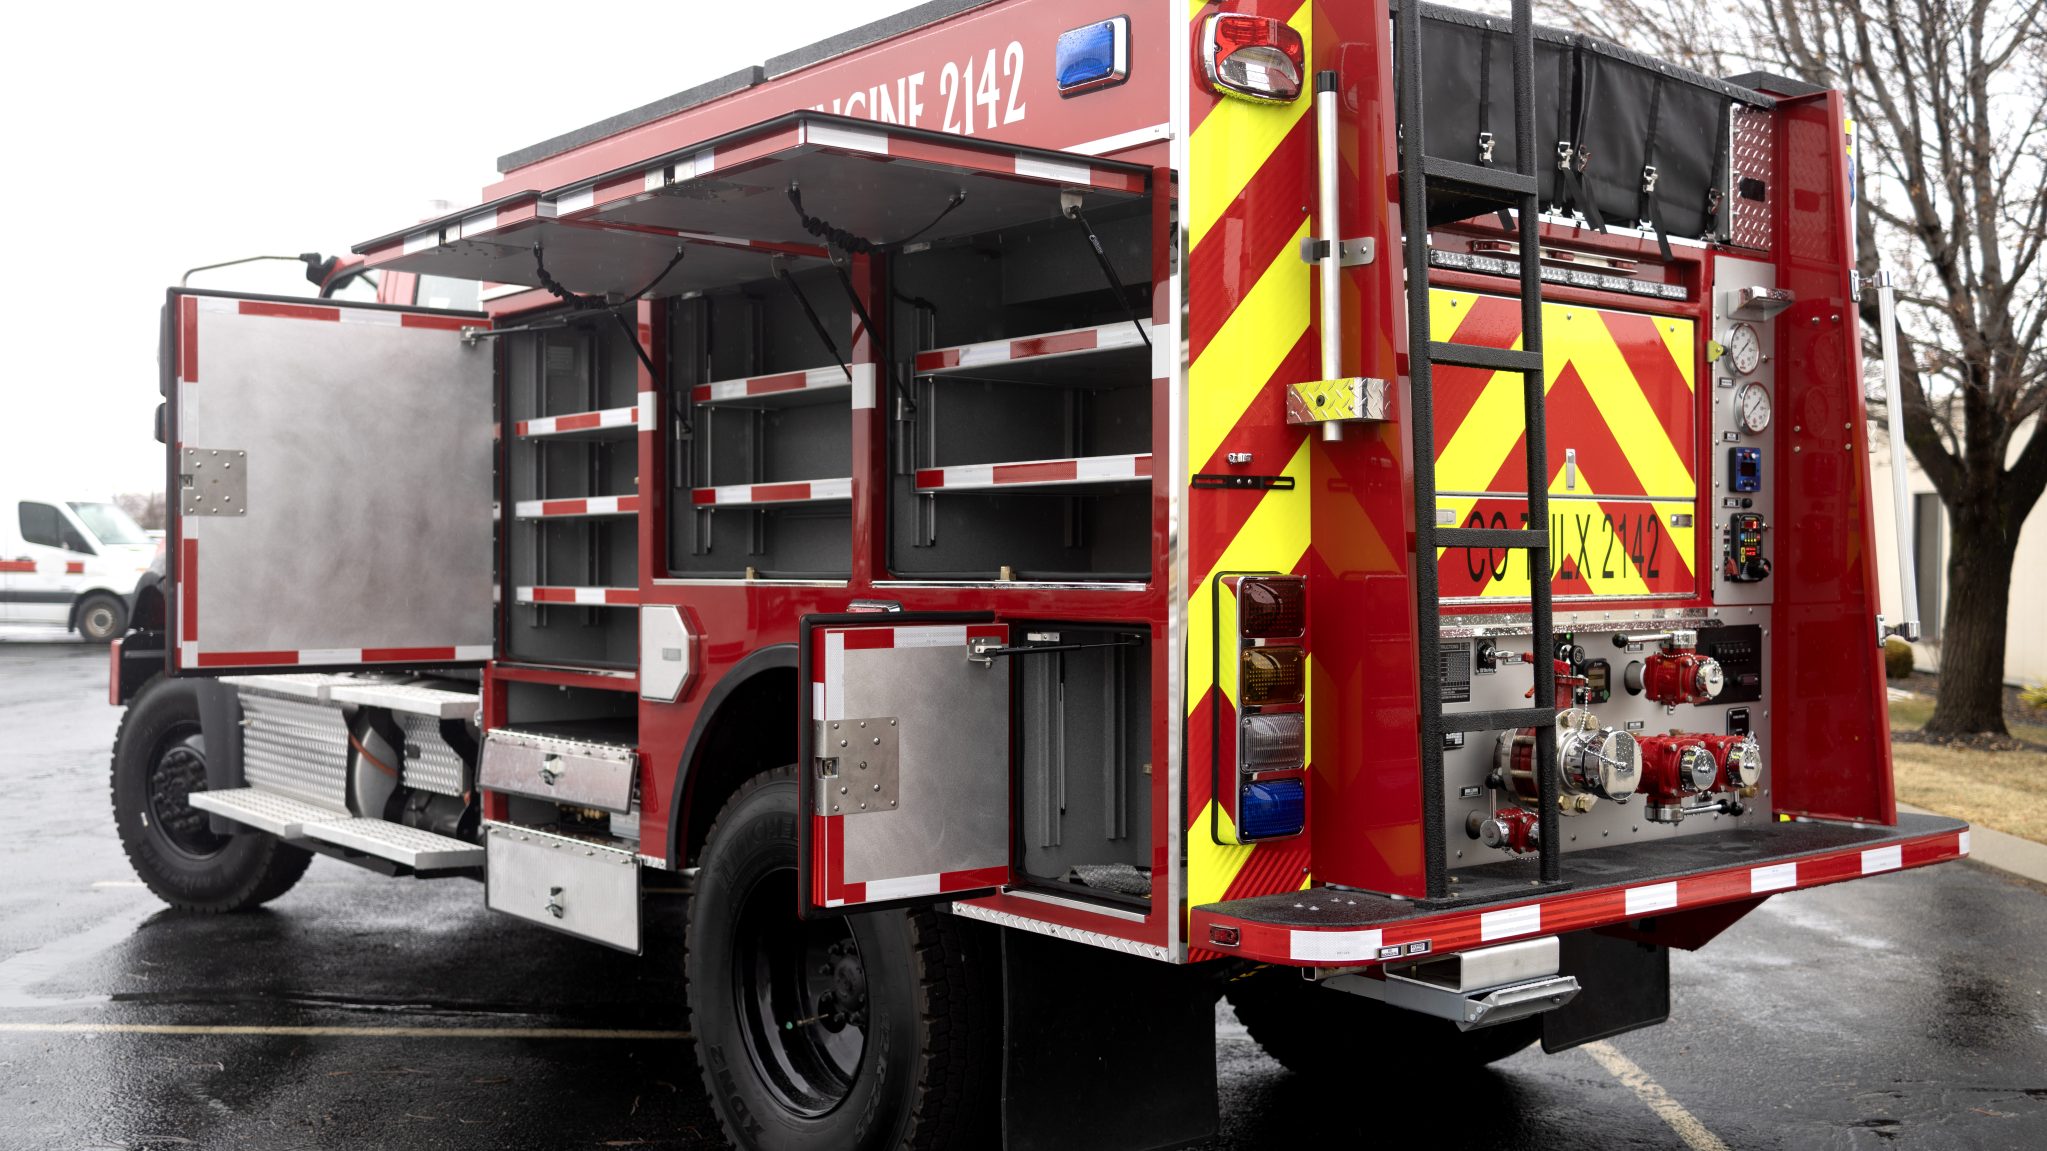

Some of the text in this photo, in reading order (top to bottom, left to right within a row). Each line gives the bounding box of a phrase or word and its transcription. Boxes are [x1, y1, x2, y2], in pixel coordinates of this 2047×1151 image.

[940, 41, 1026, 136] 2142
[1467, 511, 1508, 582] CO
[1602, 513, 1659, 579] 2142
